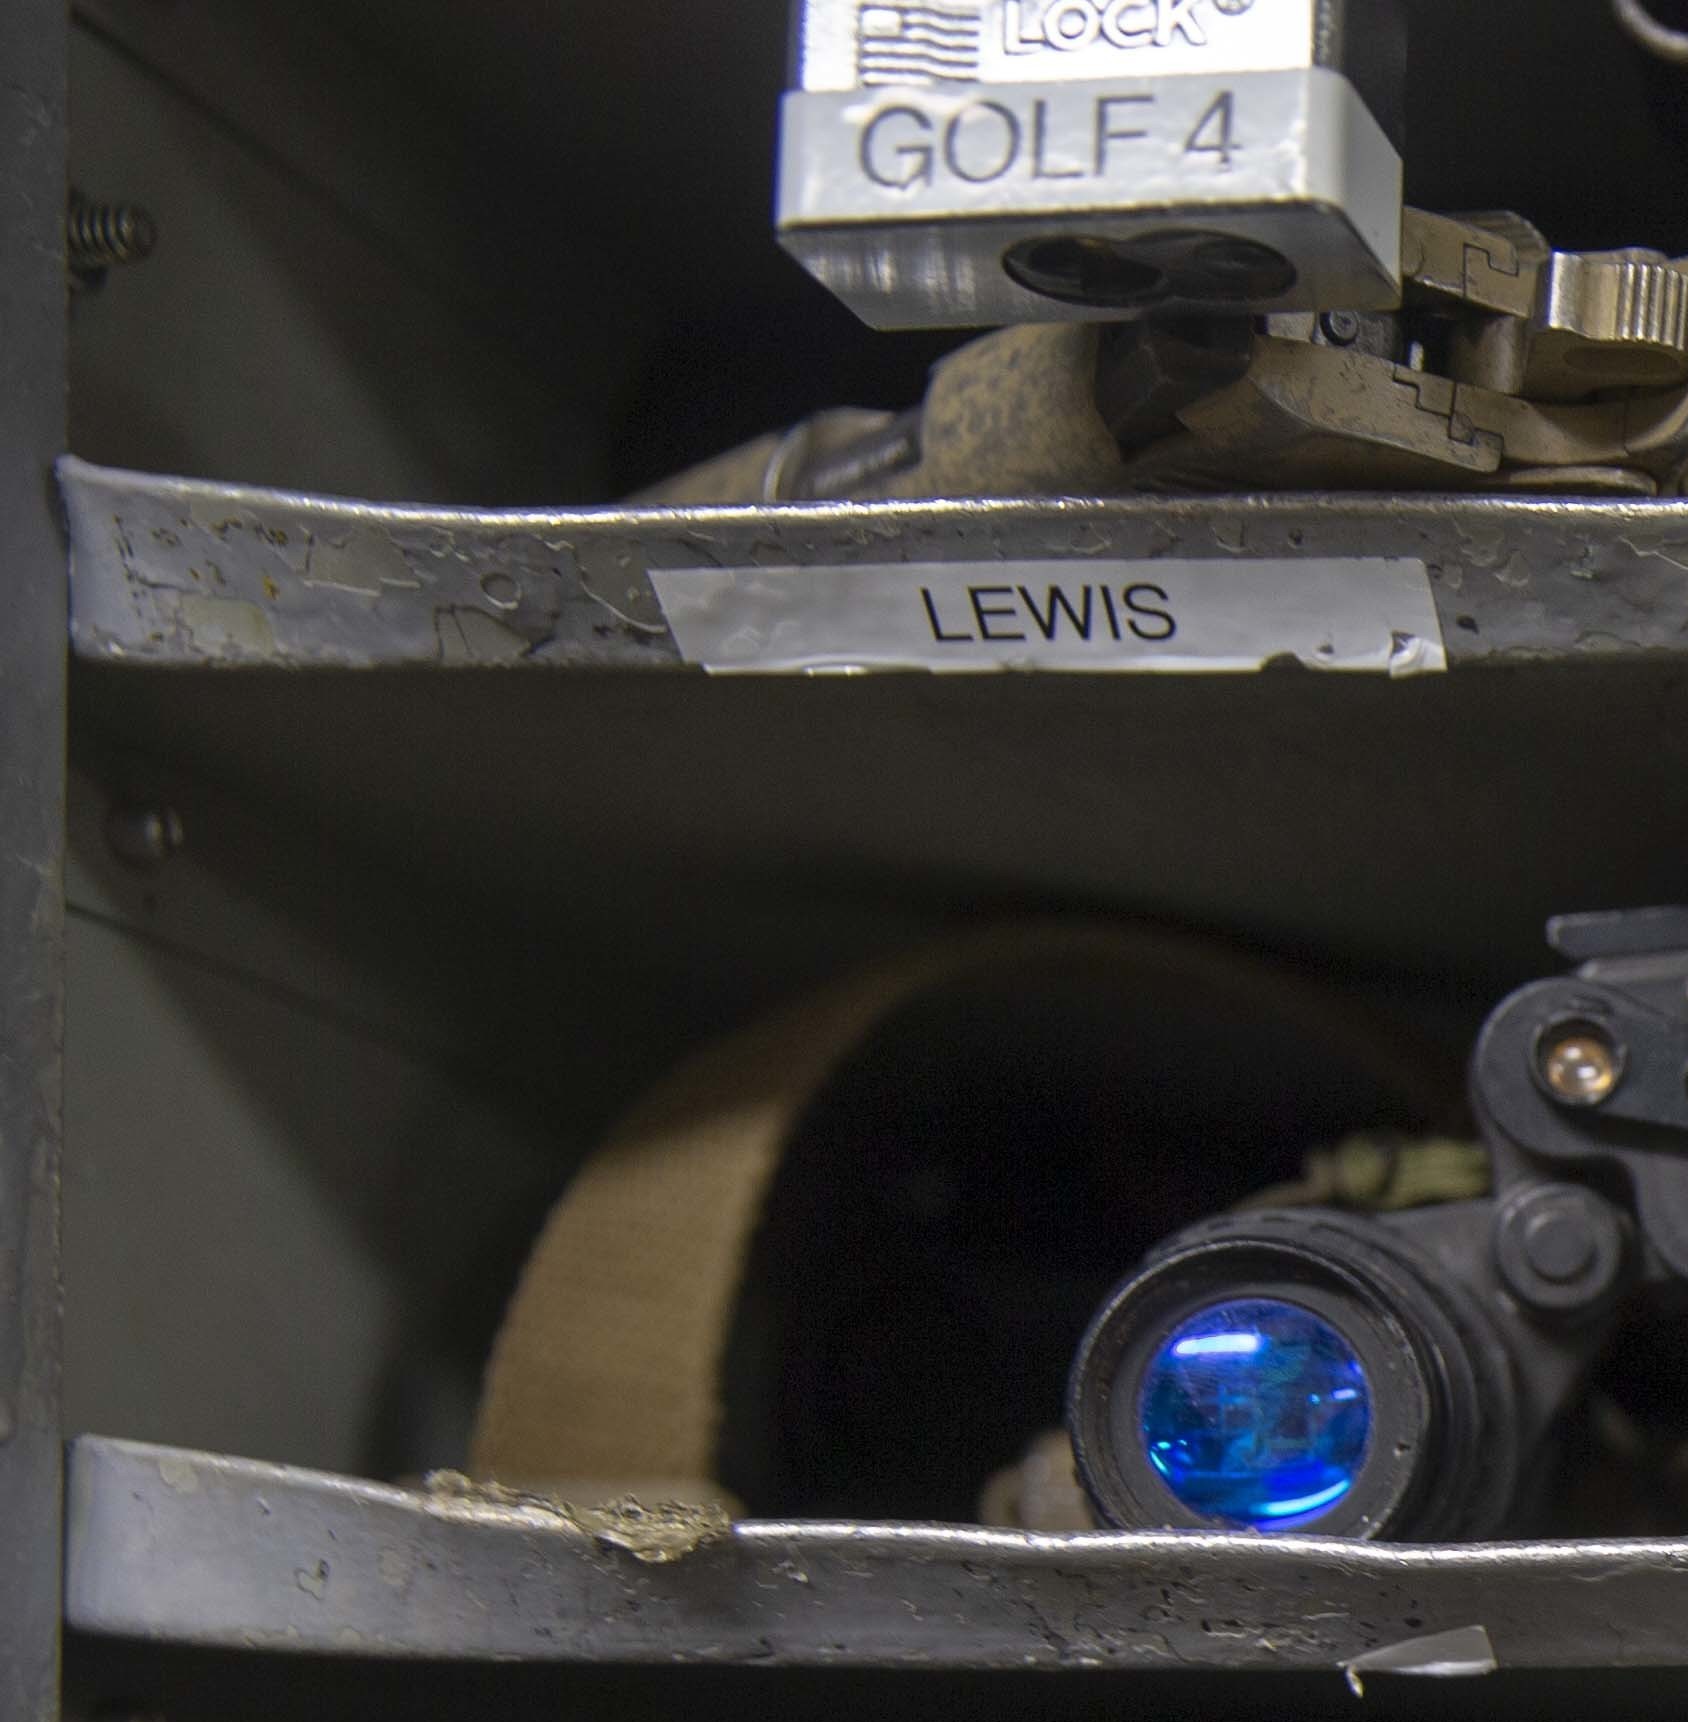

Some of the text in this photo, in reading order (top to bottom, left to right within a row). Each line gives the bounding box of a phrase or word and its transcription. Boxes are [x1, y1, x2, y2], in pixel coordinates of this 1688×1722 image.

[1002, 0, 1208, 55] LOCK
[859, 91, 1241, 190] GOLF 4
[920, 582, 1177, 643] LEWIS
